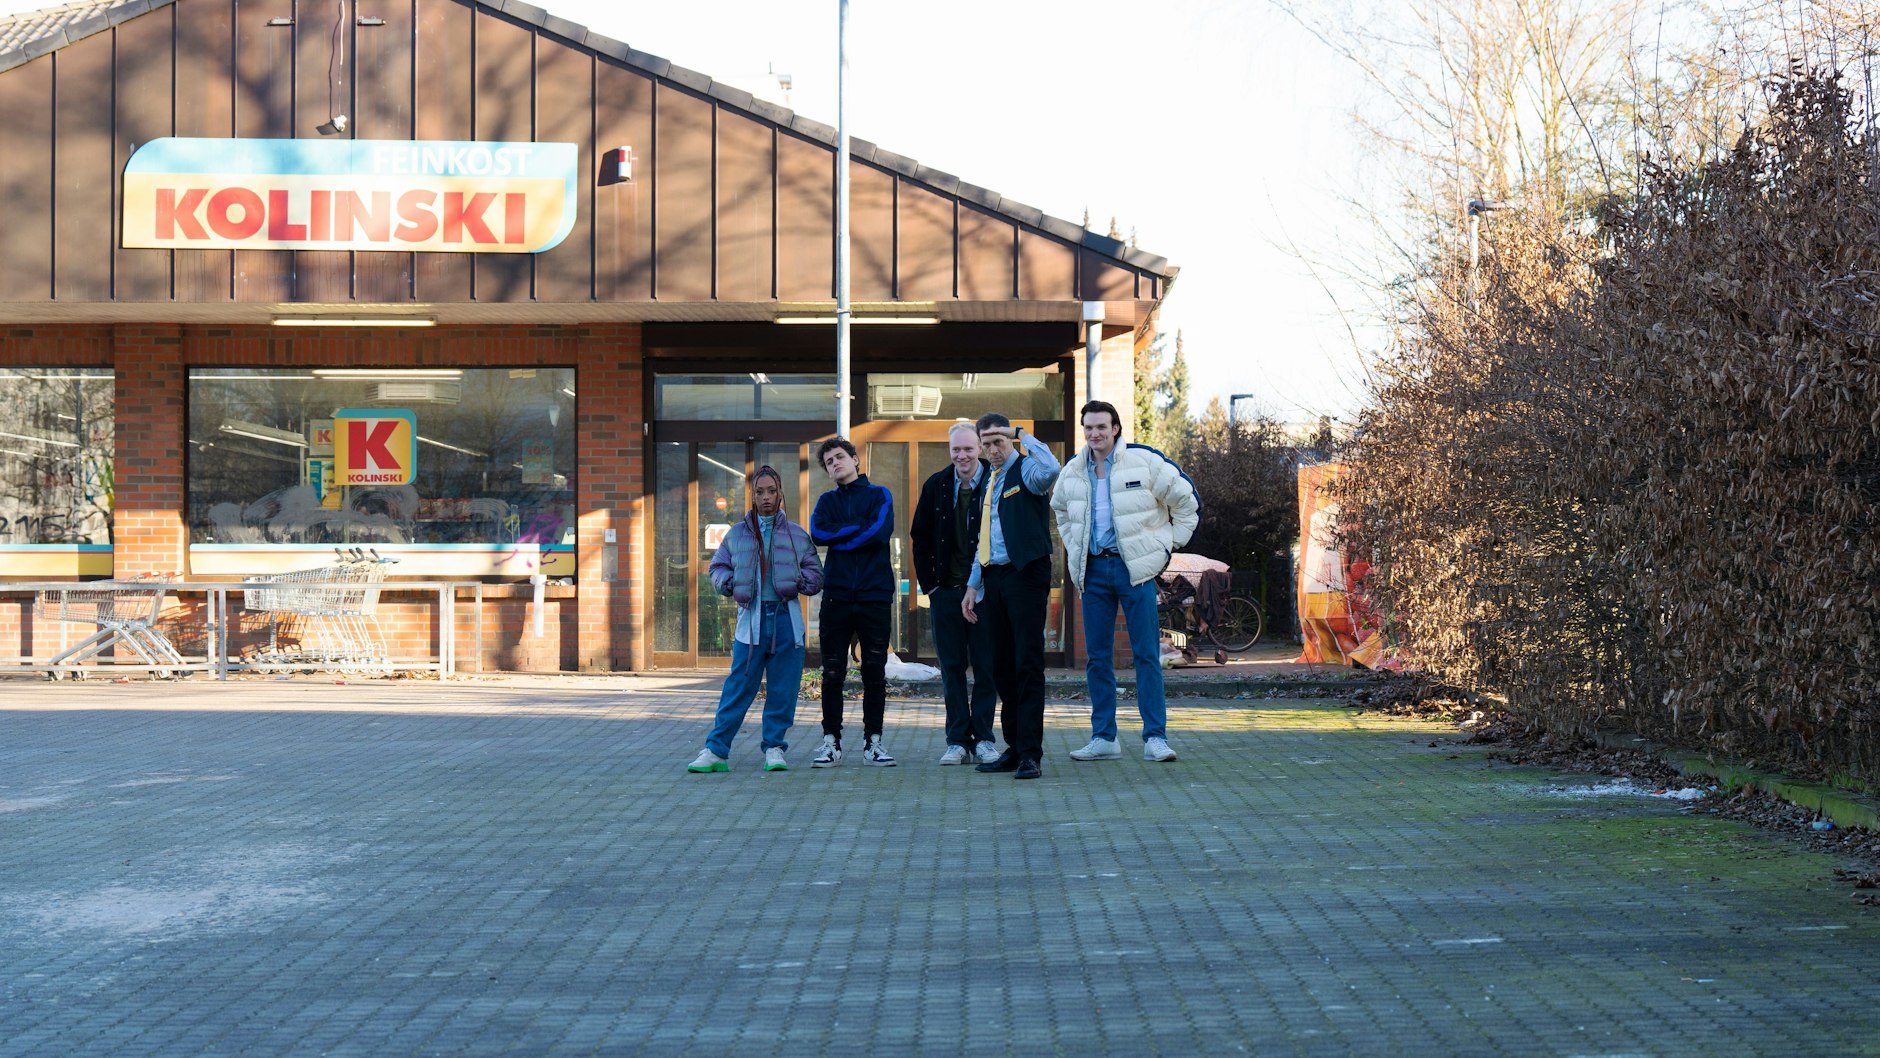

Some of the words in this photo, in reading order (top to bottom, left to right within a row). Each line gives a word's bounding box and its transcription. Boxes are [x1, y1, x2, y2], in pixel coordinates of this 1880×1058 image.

[373, 147, 532, 175] FEINKOST
[155, 187, 526, 244] KOLINSKI
[317, 430, 331, 442] K
[348, 421, 401, 469] K
[347, 474, 402, 482] KOLINSKI
[709, 528, 726, 544] K
